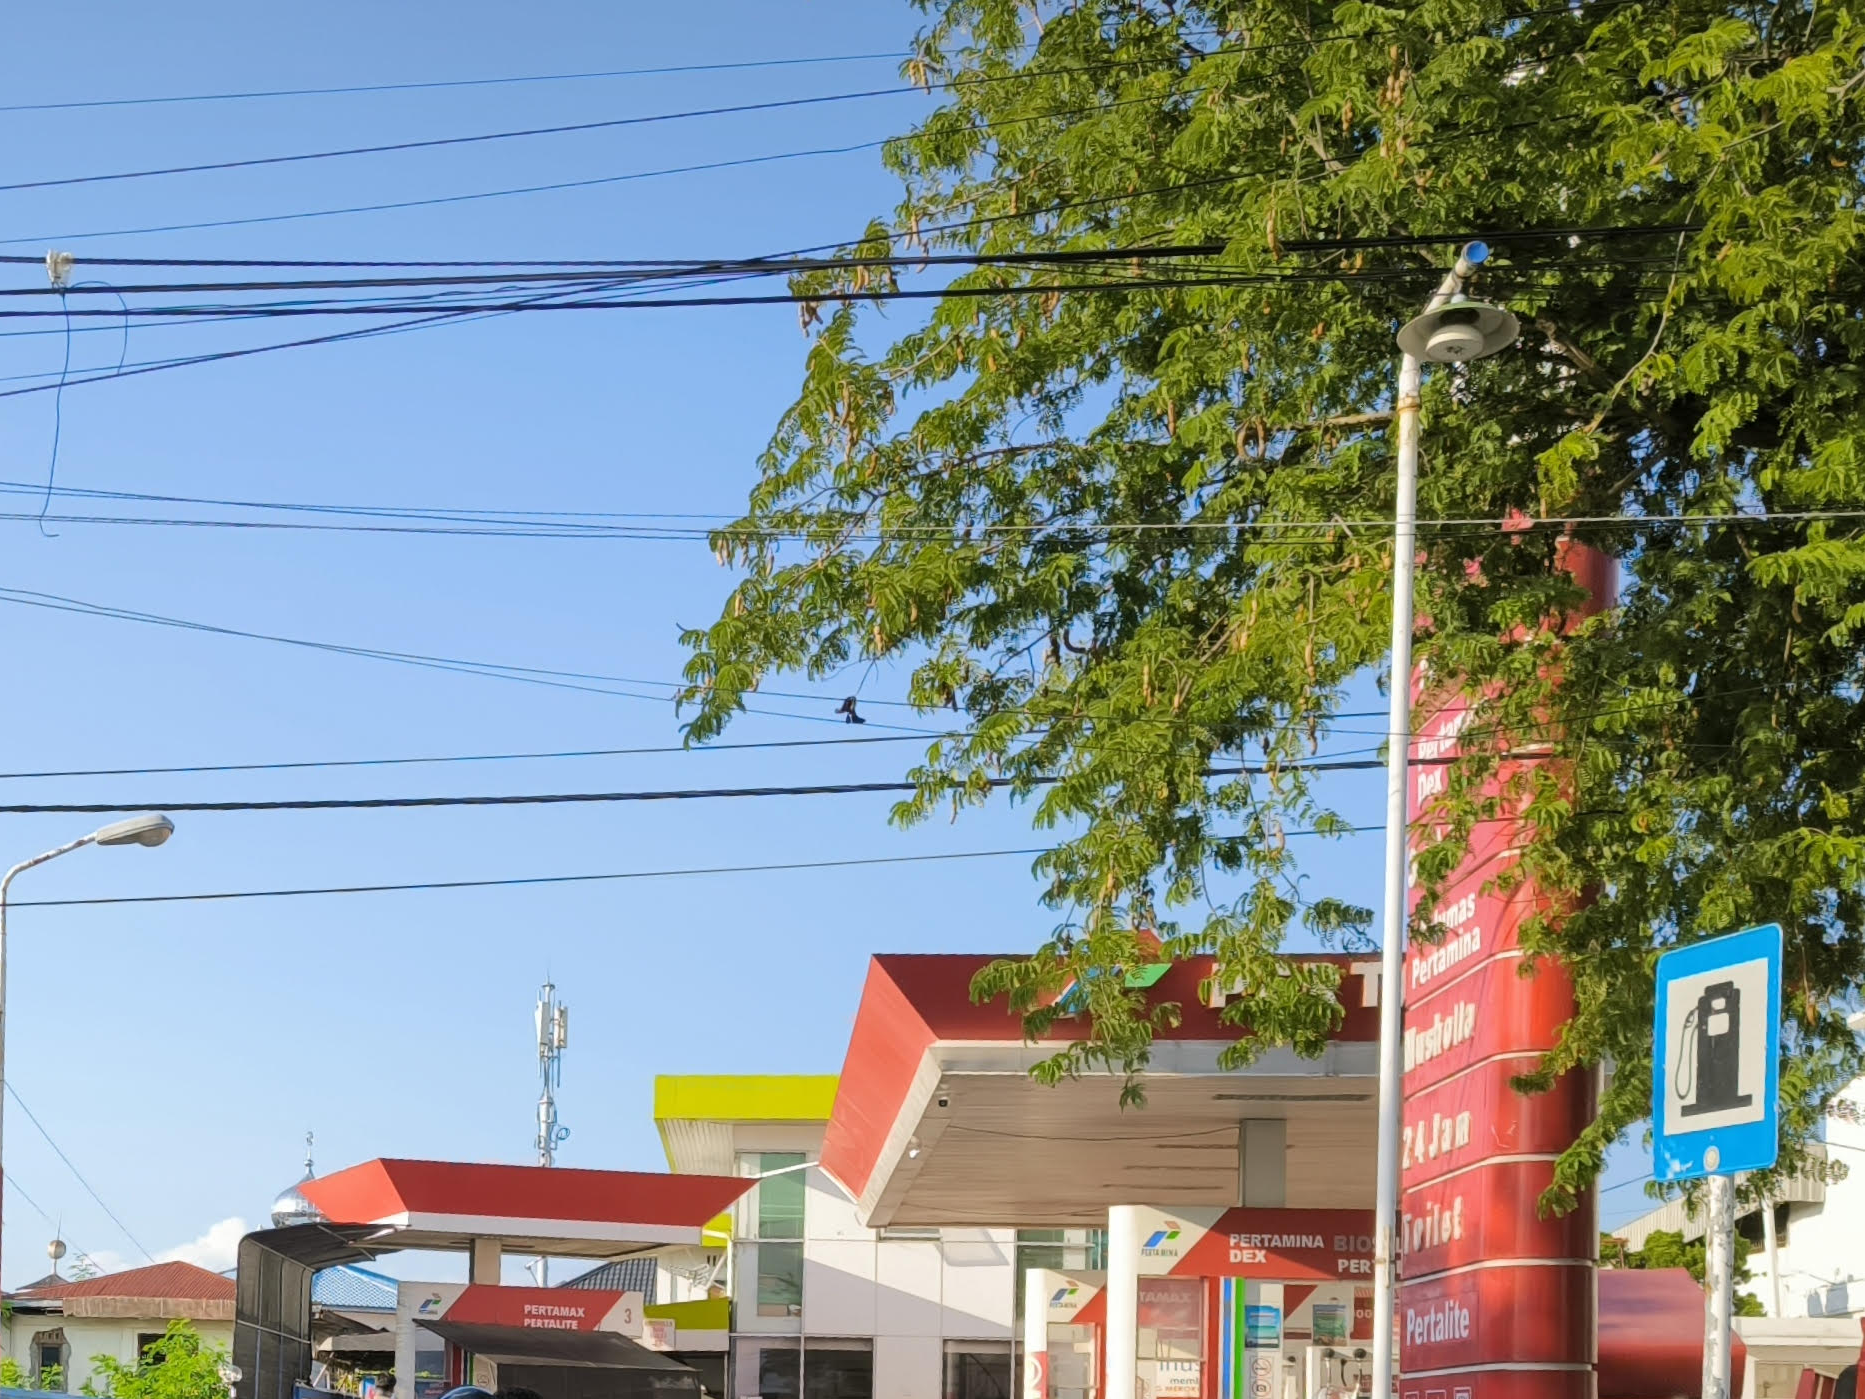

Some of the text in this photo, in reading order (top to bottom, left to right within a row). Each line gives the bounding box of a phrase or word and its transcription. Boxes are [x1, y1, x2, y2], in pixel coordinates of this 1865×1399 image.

[1417, 768, 1442, 807] Dex
[1411, 926, 1481, 989] Pertamina
[1404, 1000, 1476, 1073] Musholla
[1402, 1111, 1471, 1170] 24 Jam
[1230, 1234, 1325, 1249] PERTAMINA
[1402, 1195, 1463, 1256] Toilet
[1230, 1250, 1267, 1263] DEX
[524, 1304, 632, 1325] PERTAMAX 3
[524, 1318, 578, 1330] PERTALITE
[1406, 1299, 1470, 1346] Pertalite
